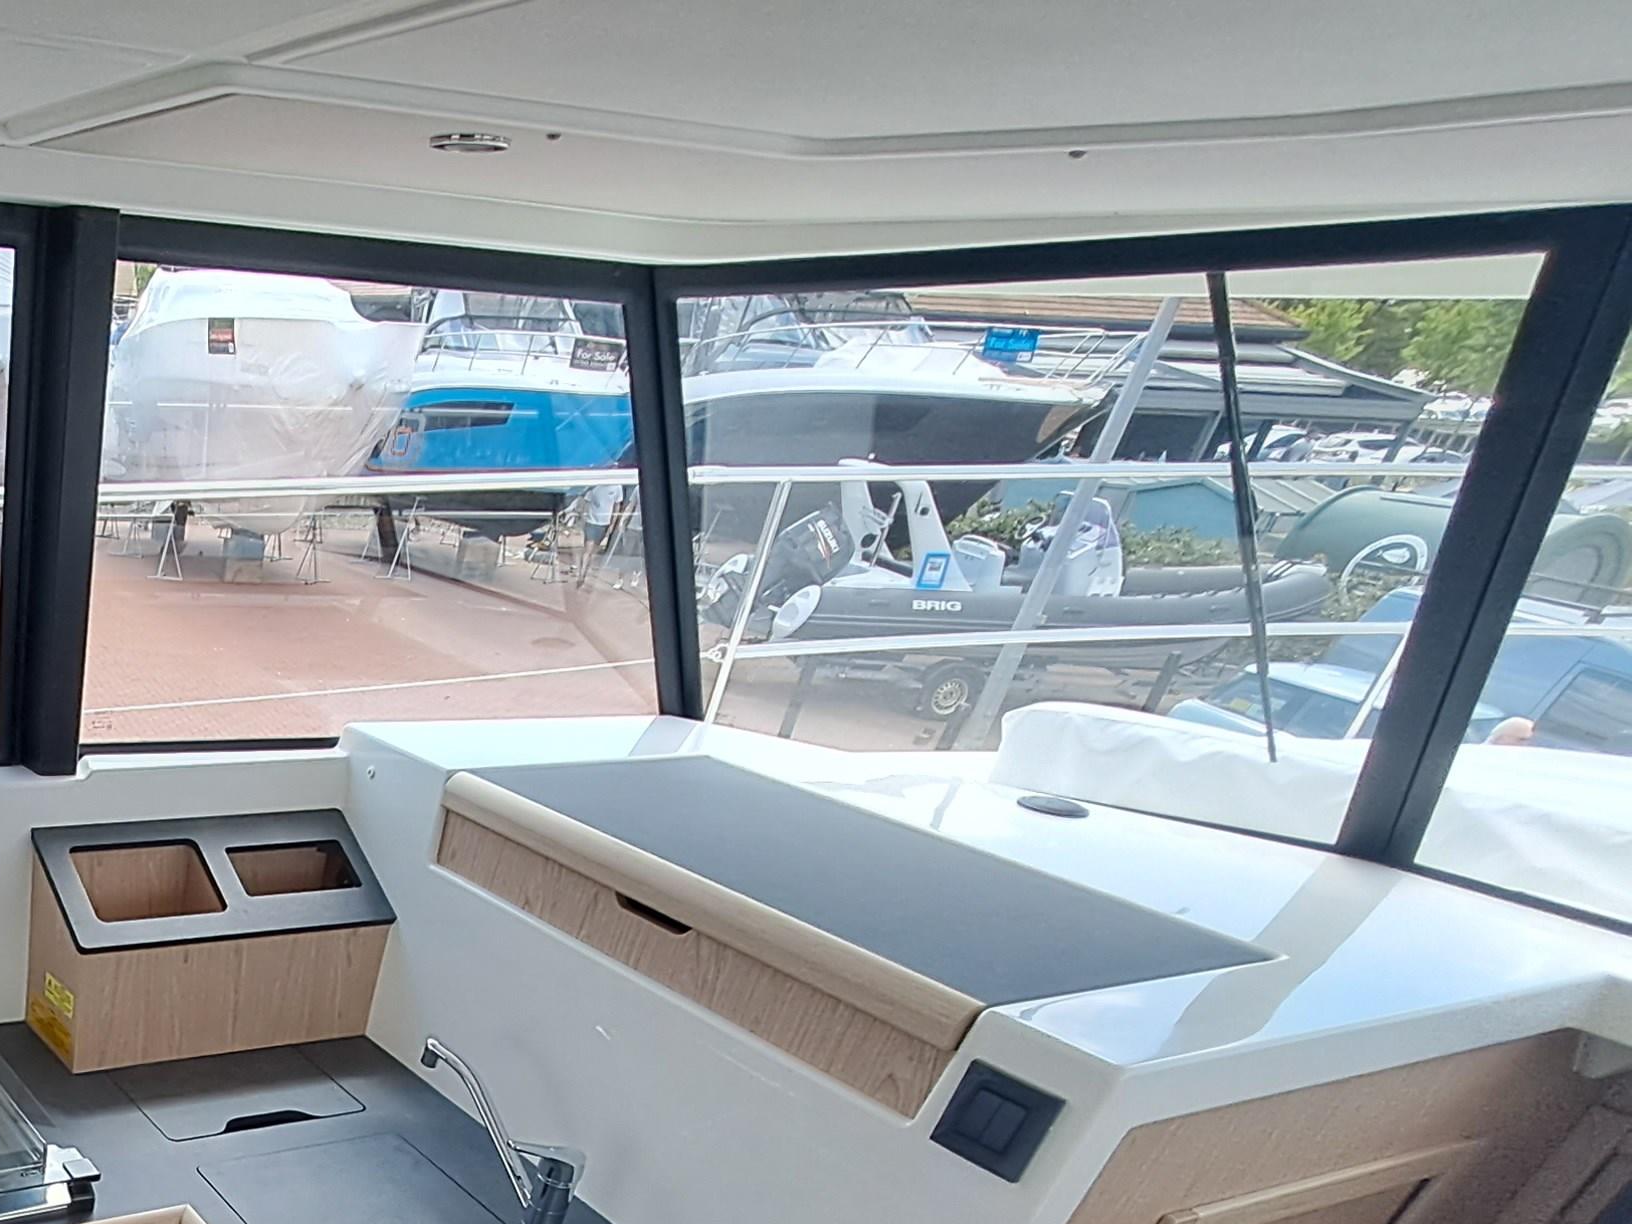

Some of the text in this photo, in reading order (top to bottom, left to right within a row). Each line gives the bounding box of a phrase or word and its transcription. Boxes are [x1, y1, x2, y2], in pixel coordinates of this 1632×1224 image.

[577, 348, 616, 361] For Sale
[817, 519, 840, 554] SUZUKI
[912, 600, 962, 612] BRIG
